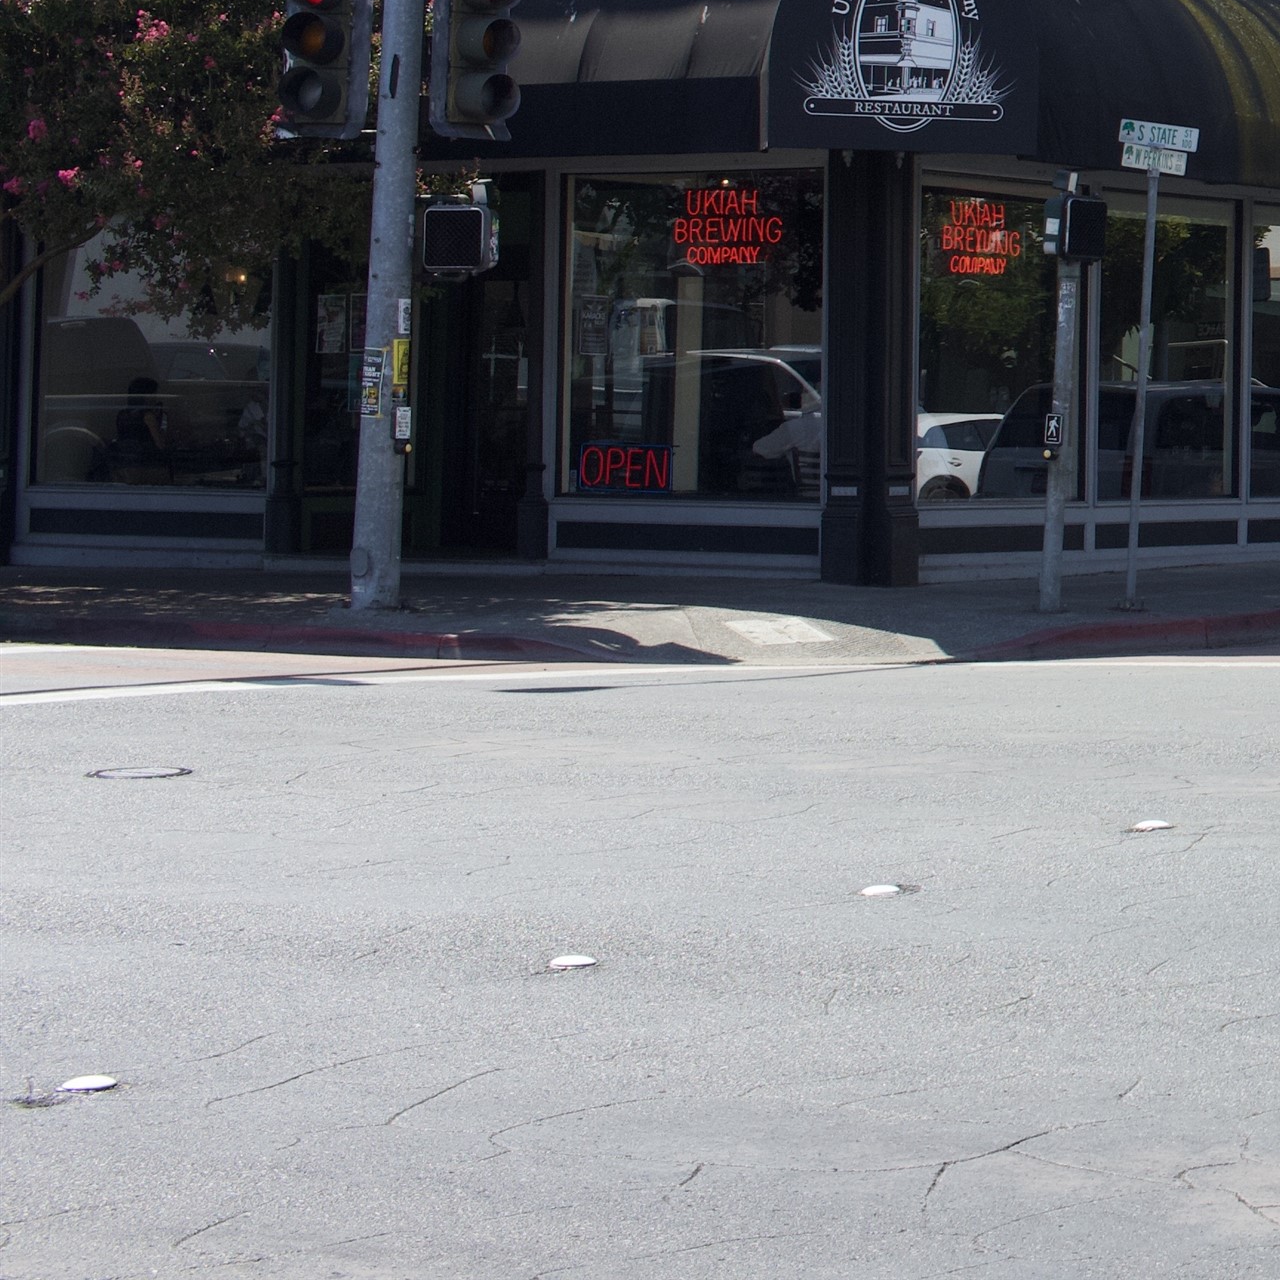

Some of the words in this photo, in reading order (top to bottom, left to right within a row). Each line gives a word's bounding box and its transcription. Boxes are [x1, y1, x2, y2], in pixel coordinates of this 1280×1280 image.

[854, 101, 954, 116] RESTAURANT
[1137, 124, 1145, 141] S
[1149, 126, 1178, 145] STATE
[1184, 129, 1193, 138] ST
[1142, 149, 1174, 170] PERKINS
[686, 190, 758, 215] UKIAH
[950, 201, 1006, 229] UKIAH
[674, 217, 783, 244] BREWING
[942, 225, 1020, 256] BREWING
[686, 246, 761, 264] COMPANY
[950, 255, 1007, 275] COMPANY
[580, 446, 670, 489] OPEN
